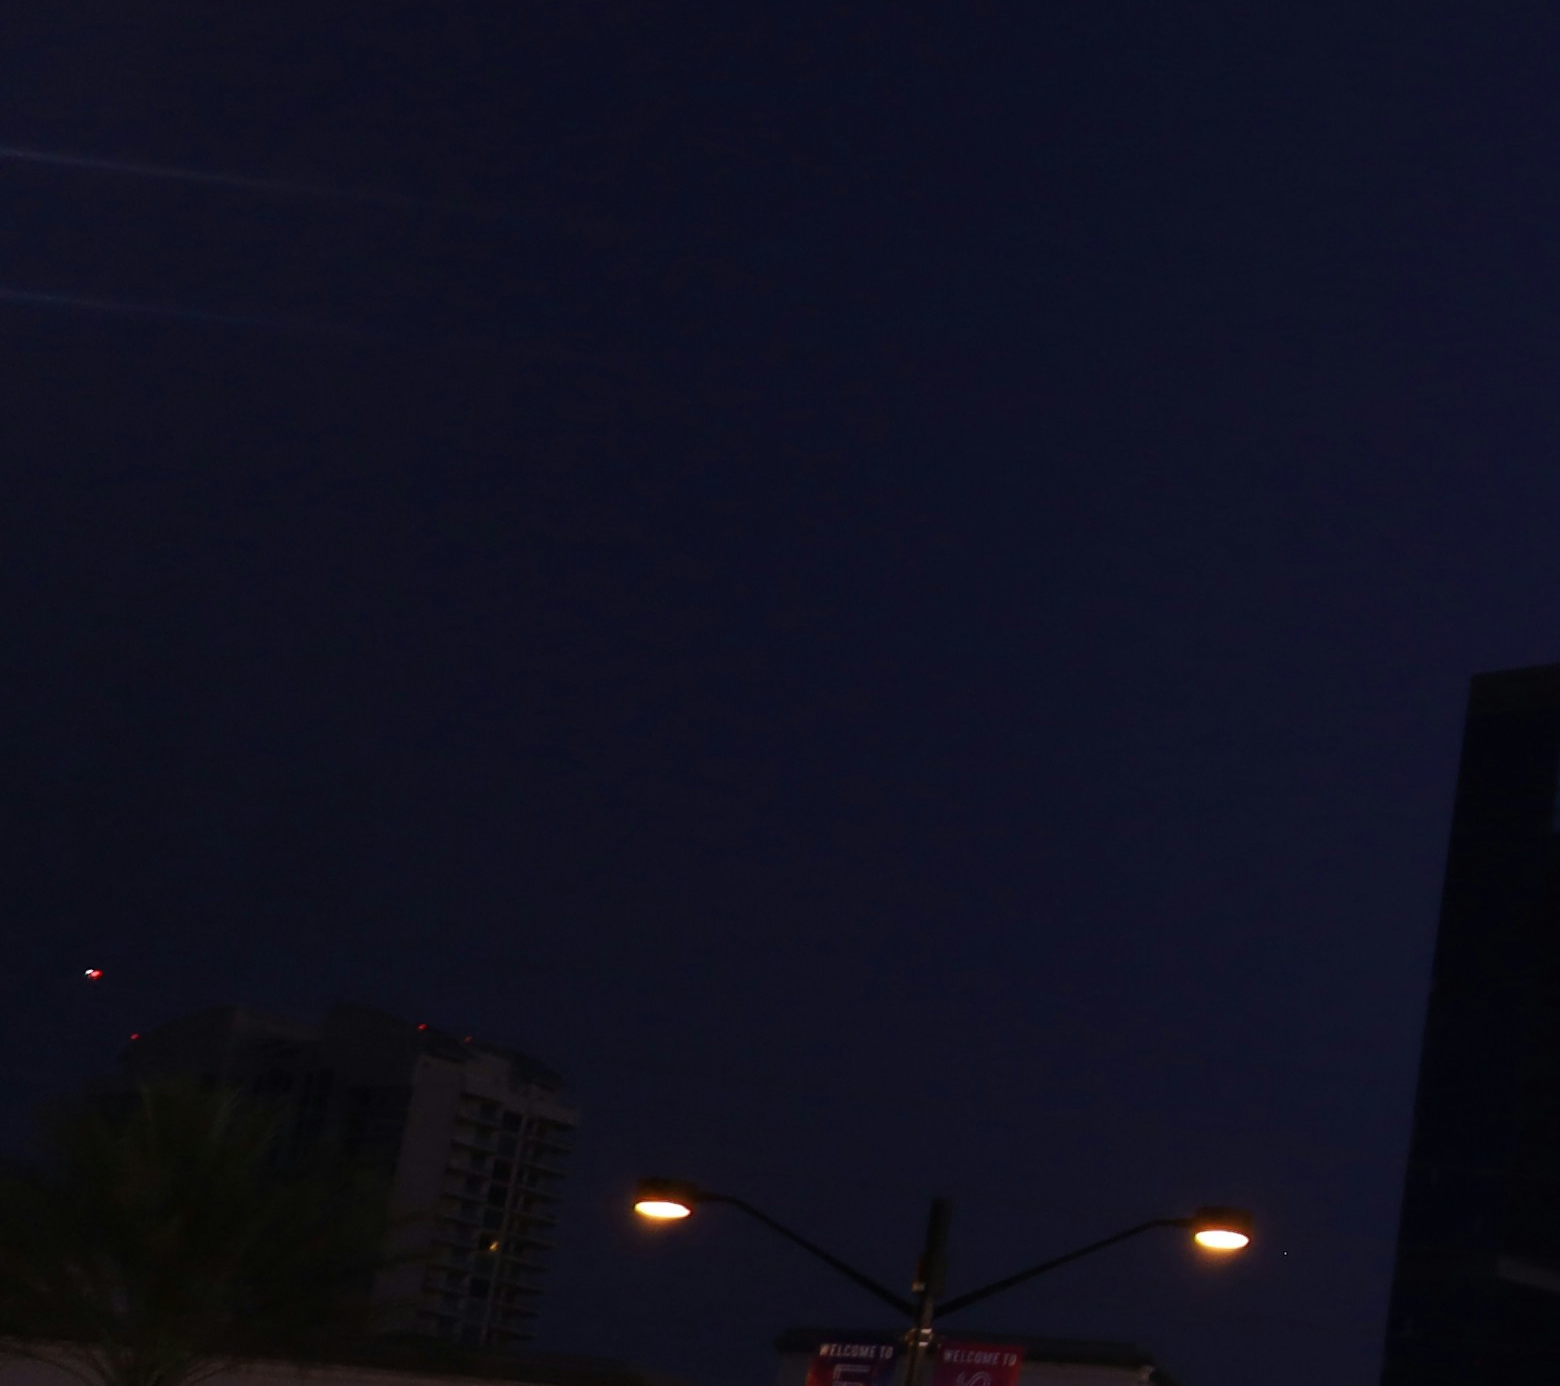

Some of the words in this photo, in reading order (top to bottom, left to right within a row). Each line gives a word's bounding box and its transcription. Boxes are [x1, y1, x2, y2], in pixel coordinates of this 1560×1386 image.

[818, 1343, 876, 1359] WELCOME
[877, 1345, 895, 1361] TO
[943, 1348, 1000, 1366] WELCOME
[1002, 1351, 1018, 1367] TO
